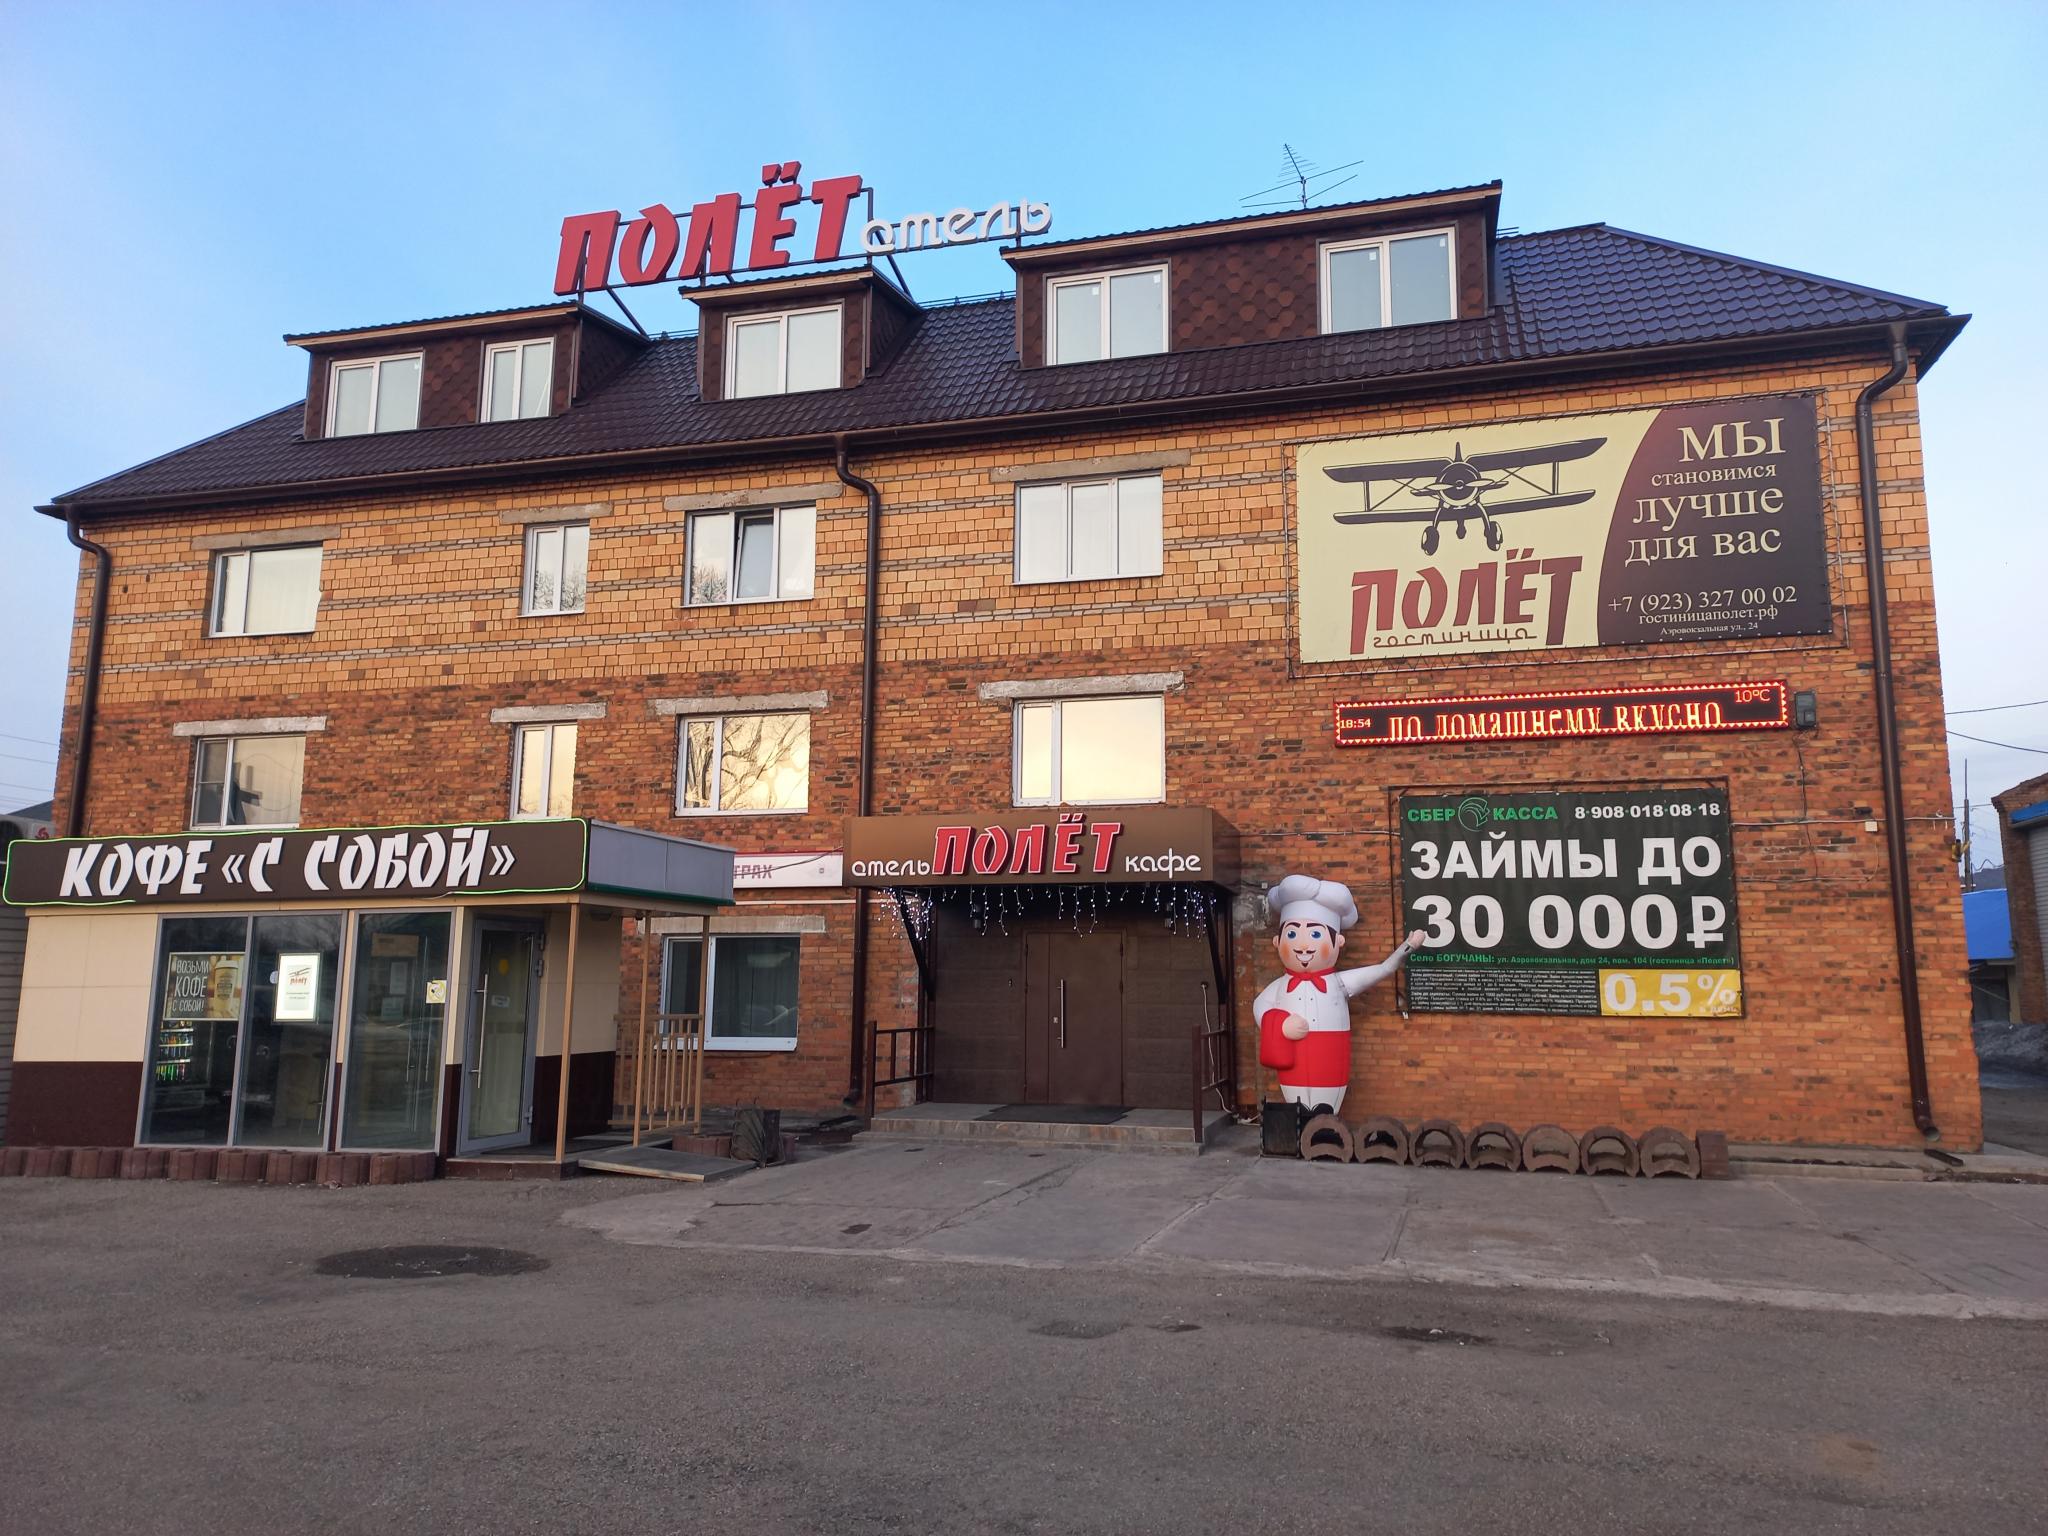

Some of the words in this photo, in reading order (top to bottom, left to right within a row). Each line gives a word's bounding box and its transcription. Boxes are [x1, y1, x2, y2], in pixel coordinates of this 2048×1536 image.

[554, 161, 863, 296] ПОЛЁТ
[860, 199, 1053, 254] отель
[1651, 463, 1777, 488] становимся
[1632, 486, 1784, 531] лучше
[1625, 534, 1698, 567] для
[1713, 528, 1782, 557] вас
[1350, 548, 1583, 654] ПОЛЁТ
[1608, 596, 1633, 613] +7
[1640, 592, 1692, 614] (923)
[1699, 589, 1735, 608] 327
[1741, 587, 1766, 605] 00
[1772, 585, 1797, 603] 02
[1639, 604, 1778, 625] гостиницаполет.рф
[1748, 622, 1758, 630] 24
[1373, 628, 1537, 648] гостиница
[1340, 718, 1371, 729] 18:54
[1407, 808, 1456, 822] СБЕР
[1493, 805, 1558, 821] КАССА
[851, 858, 931, 877] отель
[931, 812, 1124, 875] ПОЛЁТ
[1125, 848, 1202, 879] кафе
[1410, 831, 1618, 880] ЗАЙМЫ
[1637, 836, 1722, 886] ДО
[59, 838, 213, 898] КОФЕ
[221, 837, 284, 893] «С
[302, 827, 516, 892] СОБОЙ»
[1412, 894, 1504, 949] 30
[175, 959, 209, 974] ВОЗЬМИ
[1436, 953, 1495, 963] БОГУЧАНЫ:
[174, 975, 208, 998] КОФЕ
[1604, 973, 1737, 1012] 0.5%
